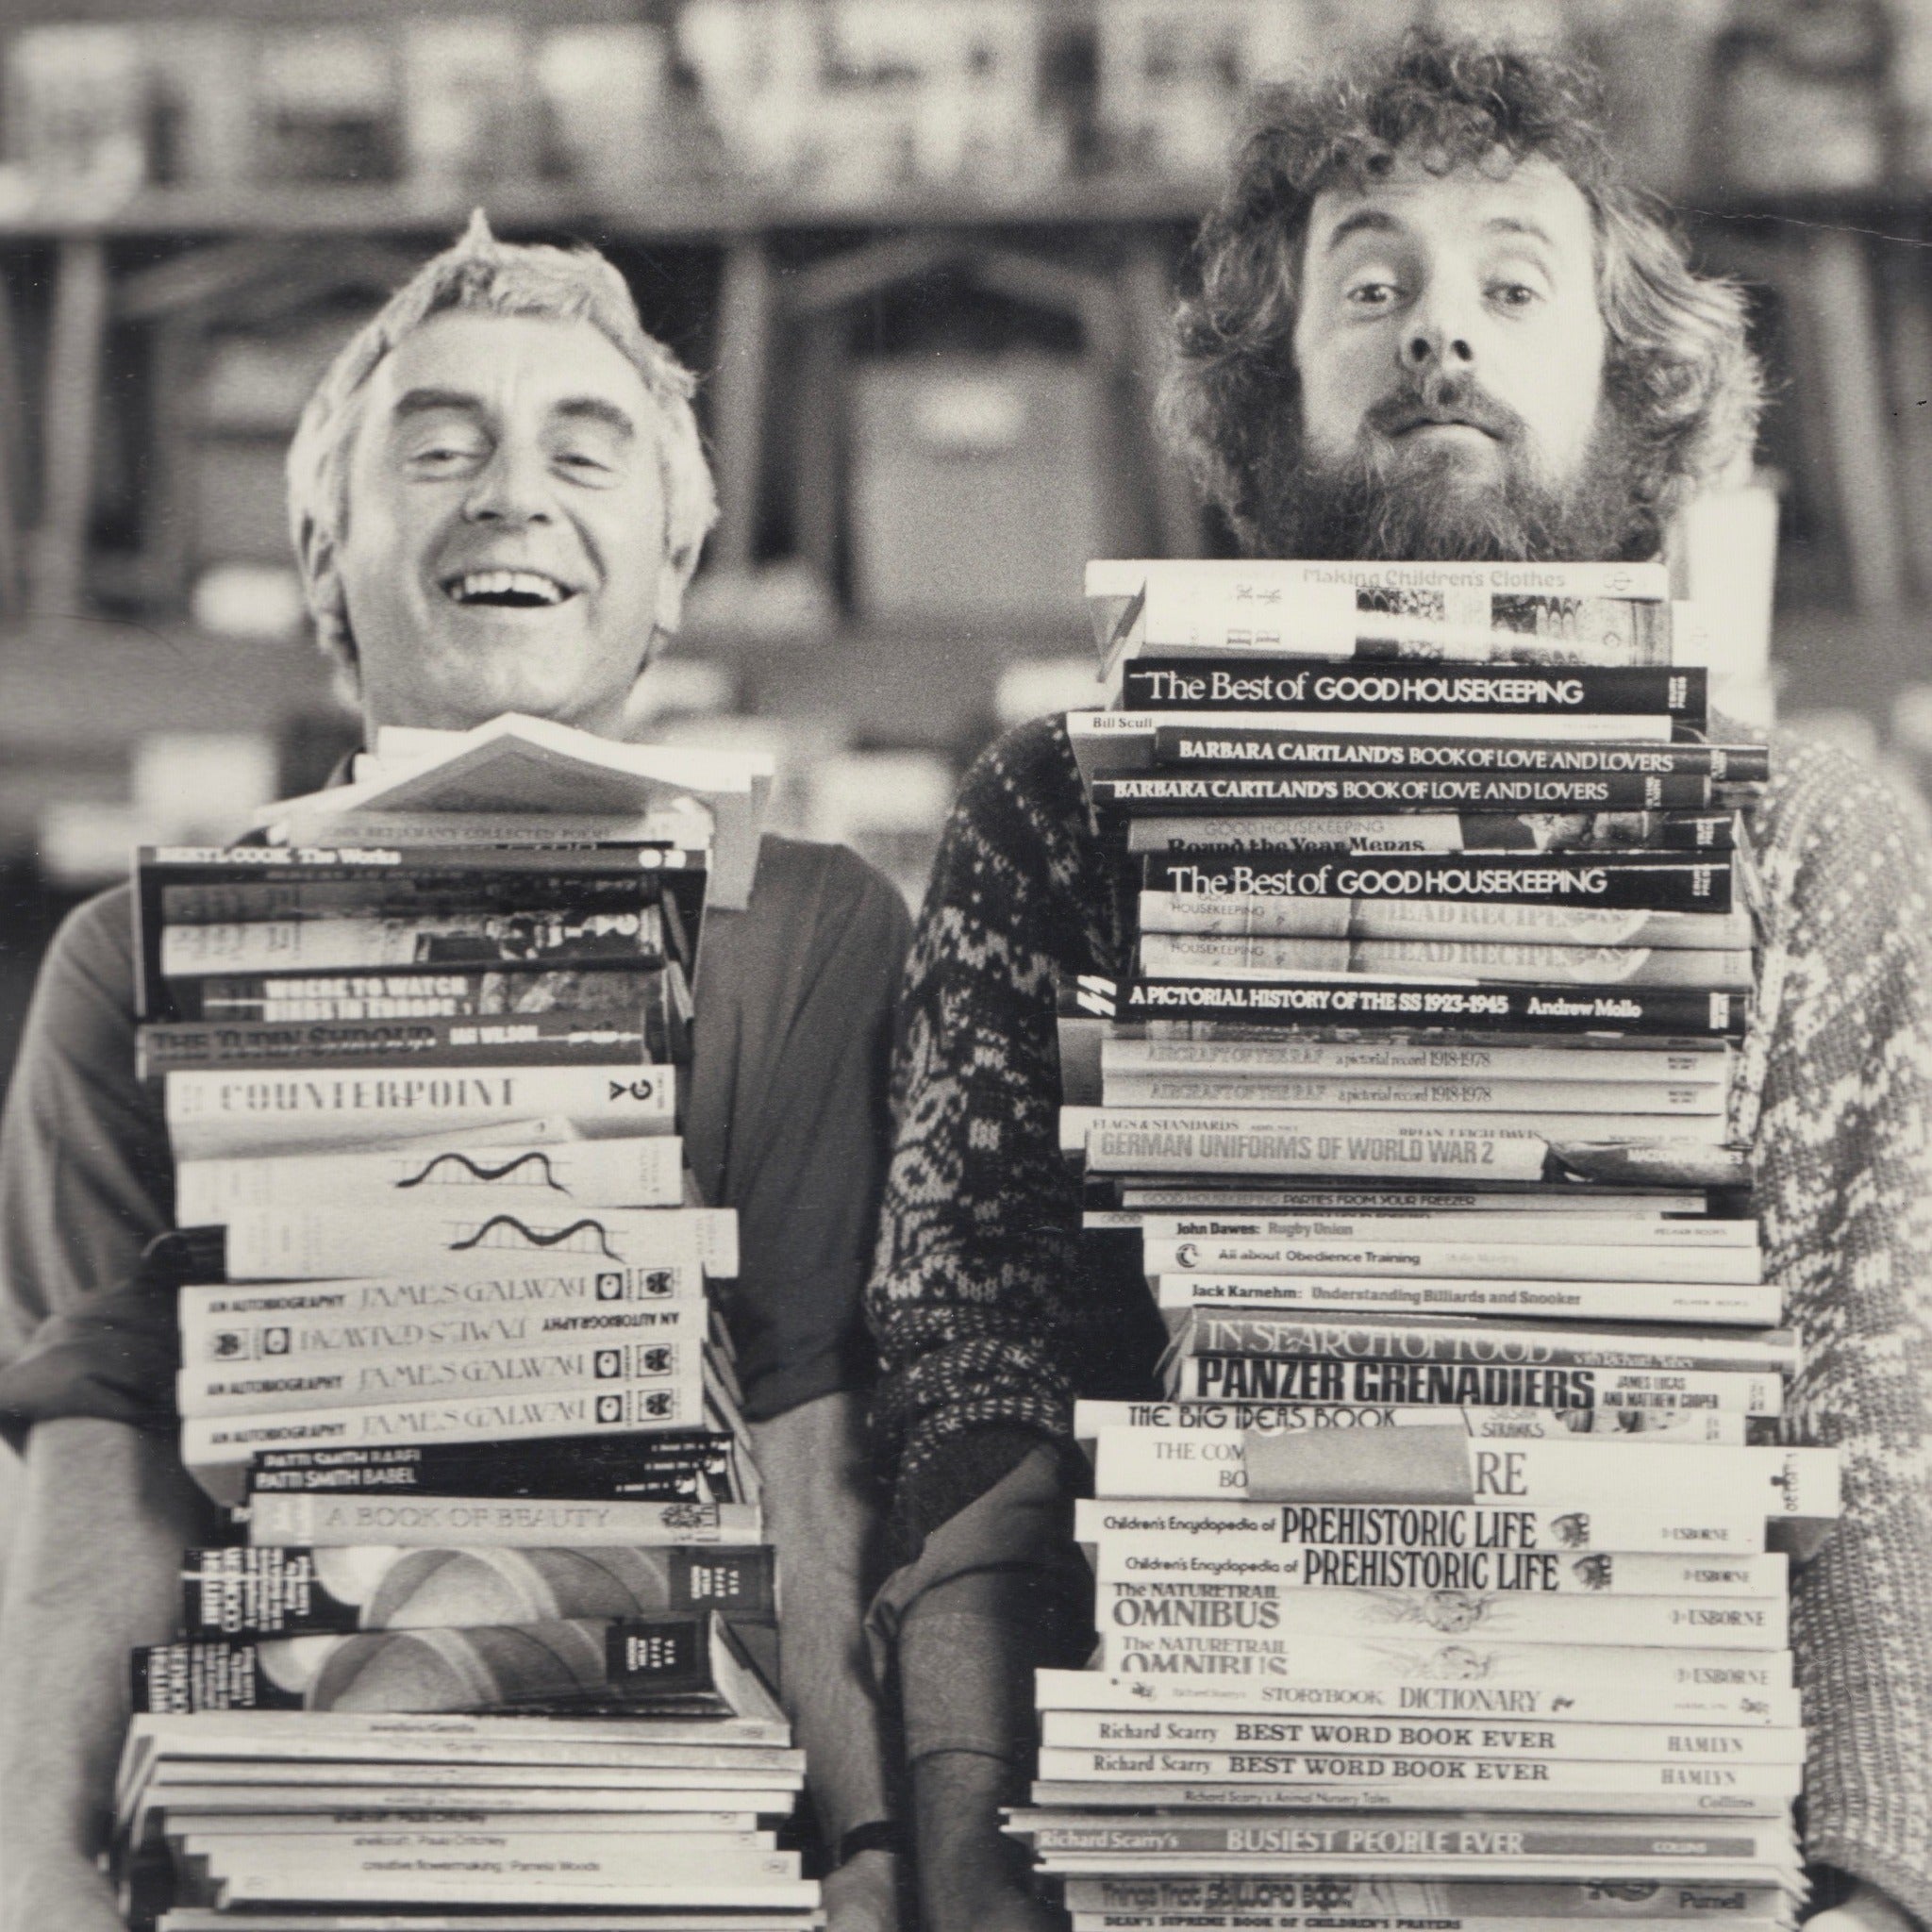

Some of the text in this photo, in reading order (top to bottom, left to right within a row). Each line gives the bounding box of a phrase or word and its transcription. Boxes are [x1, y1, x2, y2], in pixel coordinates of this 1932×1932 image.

[1303, 569, 1565, 588] Making Children's Clothes
[1144, 671, 1584, 704] The Best of GOOD HOUSEKEEPING
[1093, 717, 1115, 728] Bill
[1118, 717, 1153, 728] Scull
[1179, 741, 1674, 773] BARBARA CARTLAND'S BOOK OF LOVE AND LOVERS
[1113, 780, 1609, 801] BARBARA CARTLAND'S BOOK OF LOVE AND LOVERS
[1264, 820, 1385, 835] HOUSEKEEPING
[1167, 864, 1608, 895] The Best of GOOD HOUSEKEEPING
[1172, 903, 1265, 917] HOUSEKEEPING
[1171, 941, 1265, 956] HOUSEKEEPING
[1129, 987, 1642, 1018] A PICTORIAL HISTORY OF THE SS Andrew Mollo
[1430, 1051, 1491, 1068] 1918-1978
[221, 1078, 515, 1111] COUNTERPOINT
[1430, 1086, 1491, 1104] 1918-1978
[1092, 1119, 1240, 1132] FLAGS STANDARDS
[1101, 1132, 1494, 1165] GERMAN UNIFORMS OF WORLD WAR 2
[1283, 1191, 1476, 1207] PARTIES FROM YOUR FREEZER
[1176, 1223, 1354, 1238] John Dawes: Rugby Union
[1240, 1249, 1421, 1266] about Obedience Training
[360, 1283, 460, 1309] JAMES
[1192, 1285, 1581, 1305] Jack Karnehm: Understanding Billiards and Snooker
[541, 1314, 658, 1332] AUTOBIOGRAPHY
[1205, 1321, 1399, 1358] IN SEARCH
[358, 1363, 458, 1391] JAMES
[1196, 1357, 1595, 1409] PANZER GRENADIERS
[1617, 1375, 1651, 1391] JAMES
[361, 1411, 460, 1437] JAMES
[1129, 1406, 1398, 1429] THE BIG IDEAS BOOK
[1153, 1442, 1196, 1460] THE
[254, 1468, 417, 1490] PATTI SMITH BABEL
[357, 1507, 445, 1528] BOOK
[449, 1507, 489, 1528] OF
[495, 1507, 610, 1528] BEAUTY
[1104, 1507, 1538, 1549] Children's Encyclopedia of PREHISTORIC LIFE
[1124, 1548, 1559, 1591] Children's Encyclopedia of PREHISTORIC LIFE
[1113, 1583, 1279, 1599] The NATURETRAIL
[1113, 1599, 1281, 1629] OMNIBUS
[1123, 1636, 1289, 1654] The NATURETRAIL
[1261, 1687, 1541, 1713] STORYBOOK DICTIONARY
[1099, 1723, 1744, 1753] Richard Scarry BEST WORD BOOK EVER HAMLYN
[1093, 1755, 1737, 1787] Richard Scarry BEST WORD BOOK EVER HAMLYN
[1184, 1791, 1224, 1803] Richard
[1274, 1792, 1315, 1804] Animal
[1363, 1794, 1391, 1805] Tales
[1698, 1795, 1757, 1809] Collins
[1039, 1828, 1525, 1855] Richard Scarry's BUSIEST PEOPLE EVER
[1678, 1890, 1747, 1910] Purnell
[1104, 1916, 1461, 1931] DEAN'S SUPREME BOOK OF CHILDREN'S PRAYERS
